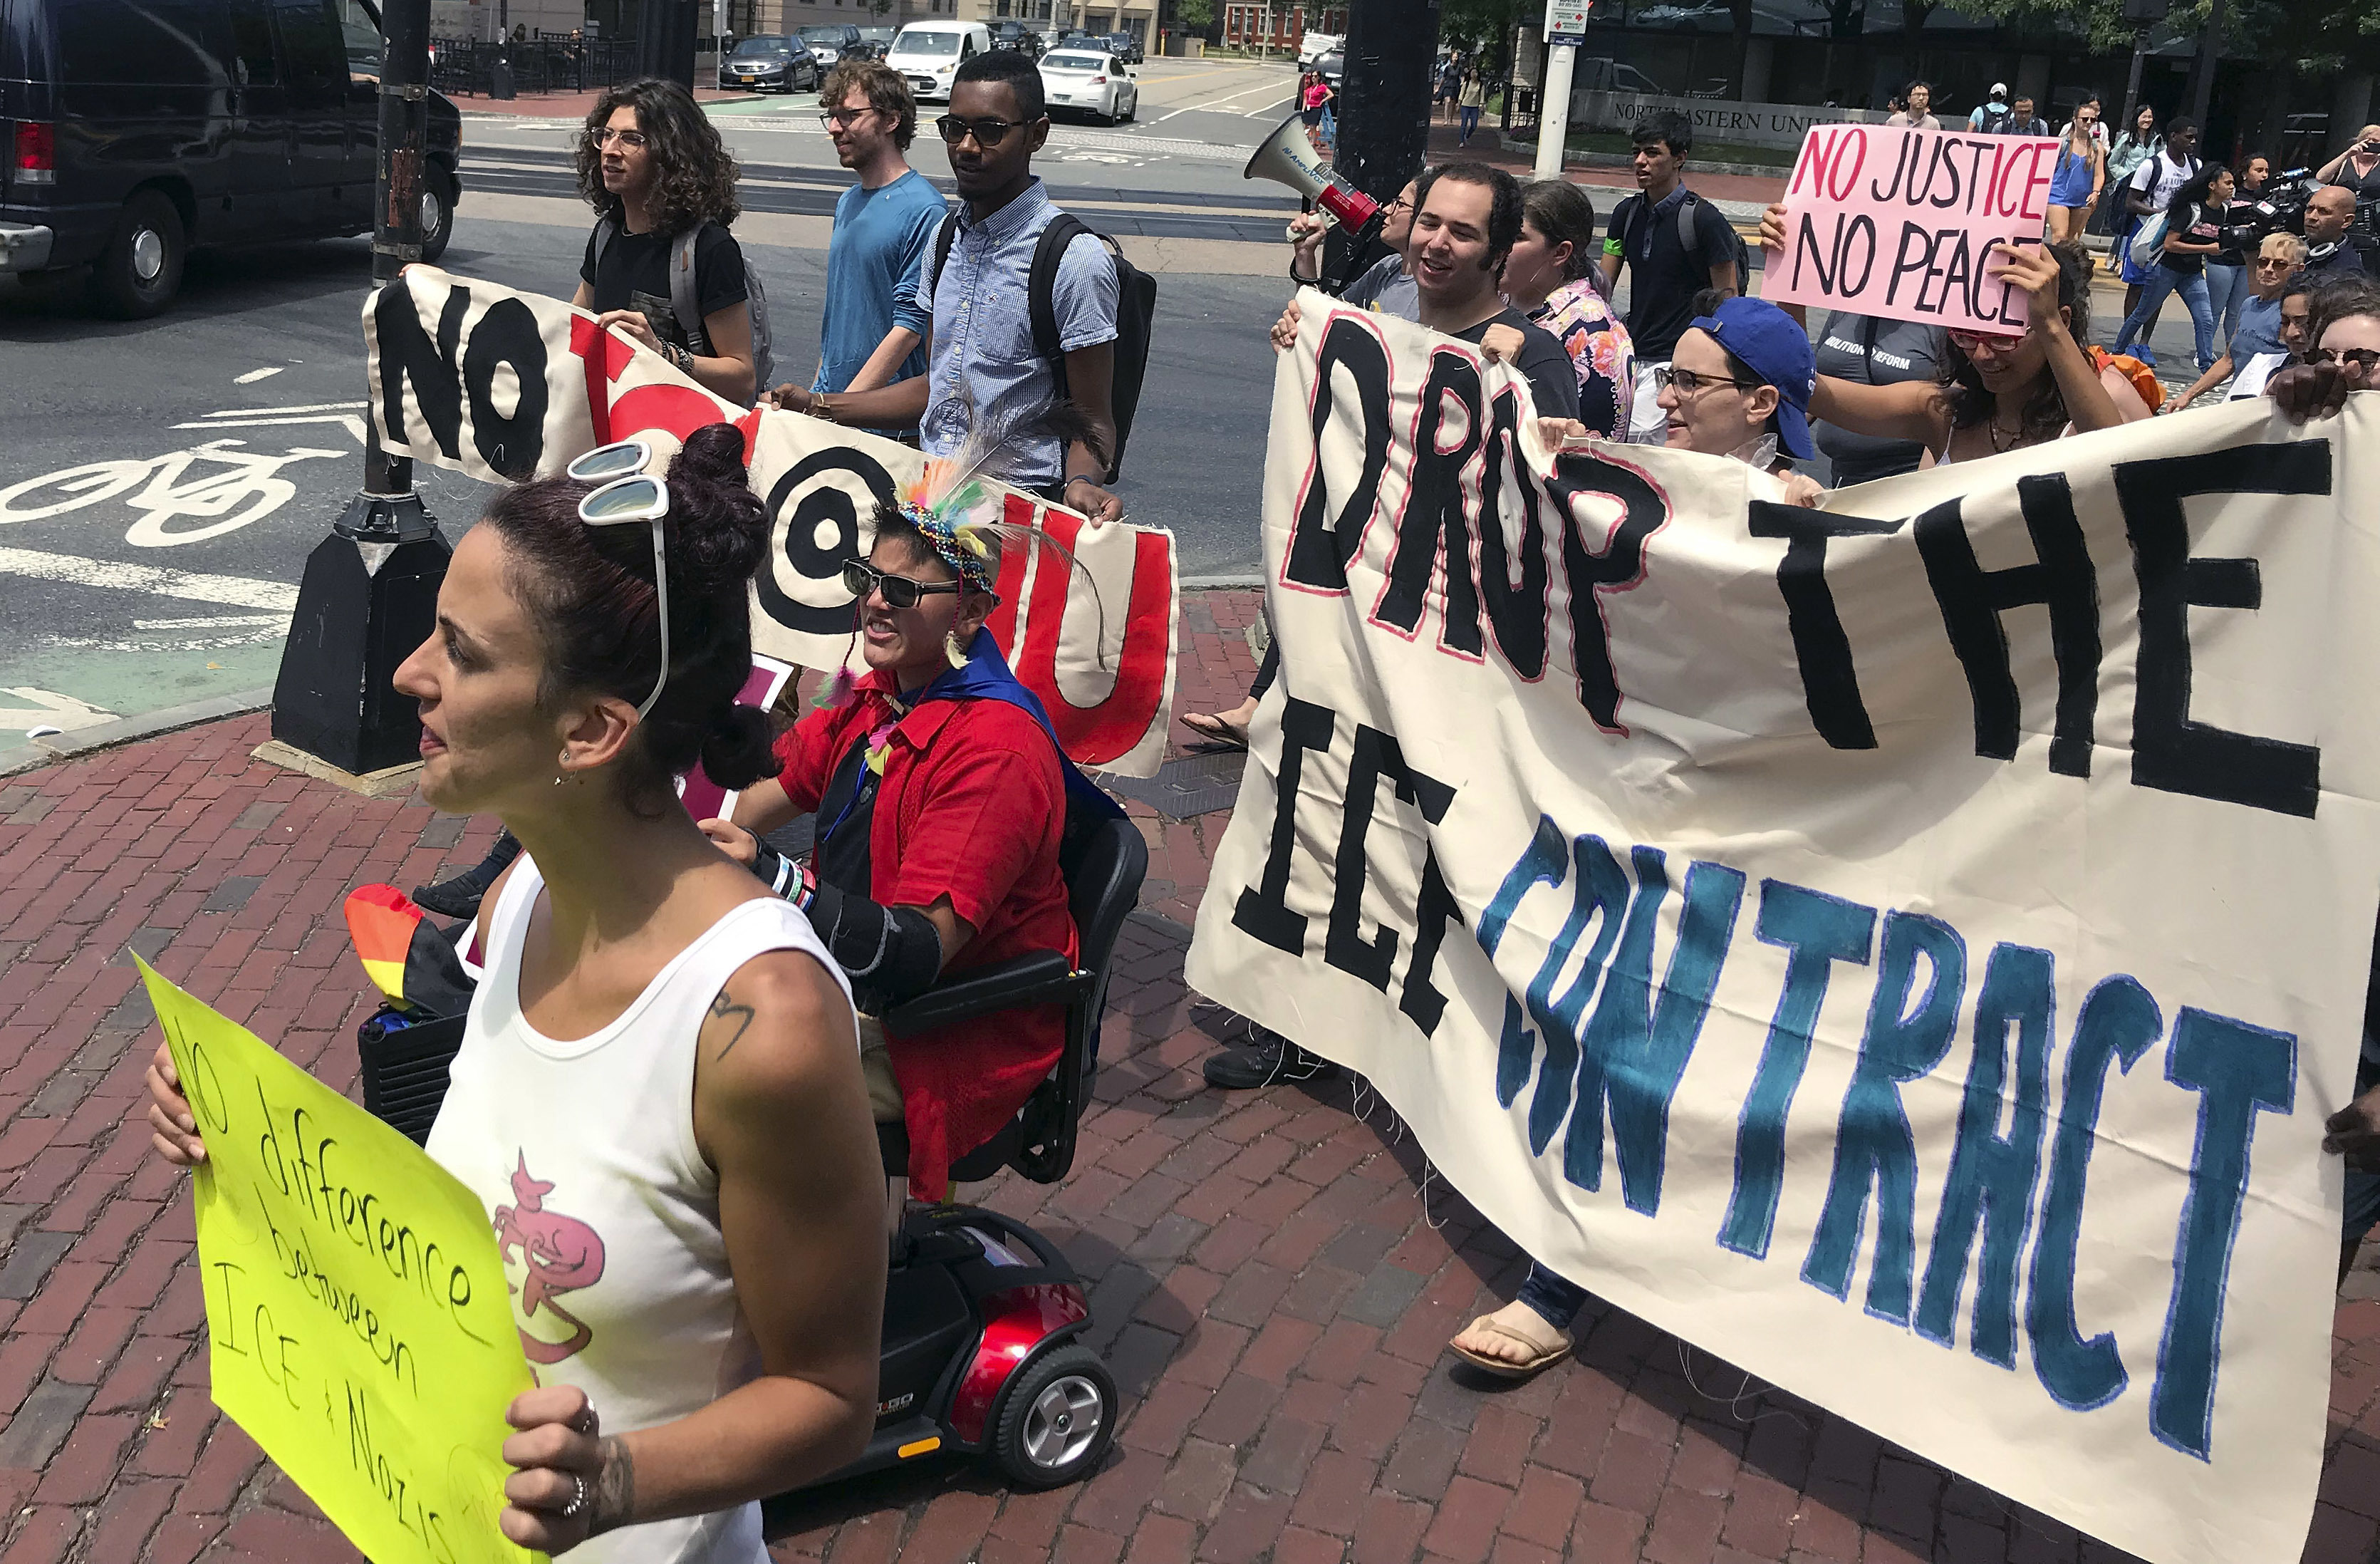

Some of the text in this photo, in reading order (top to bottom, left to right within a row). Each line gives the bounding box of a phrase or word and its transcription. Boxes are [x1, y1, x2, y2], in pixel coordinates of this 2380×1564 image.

[1614, 103, 1761, 130] NORTASTERN
[1792, 128, 2060, 220] NO JUSTICE
[1792, 212, 2042, 327] NO PEACE
[375, 276, 549, 475] NO
[1279, 309, 2332, 819] DROP THE
[256, 1074, 494, 1349] difference
[1477, 813, 2297, 1464] CONTRACT
[214, 1262, 301, 1410] ICE
[254, 1181, 418, 1401] between
